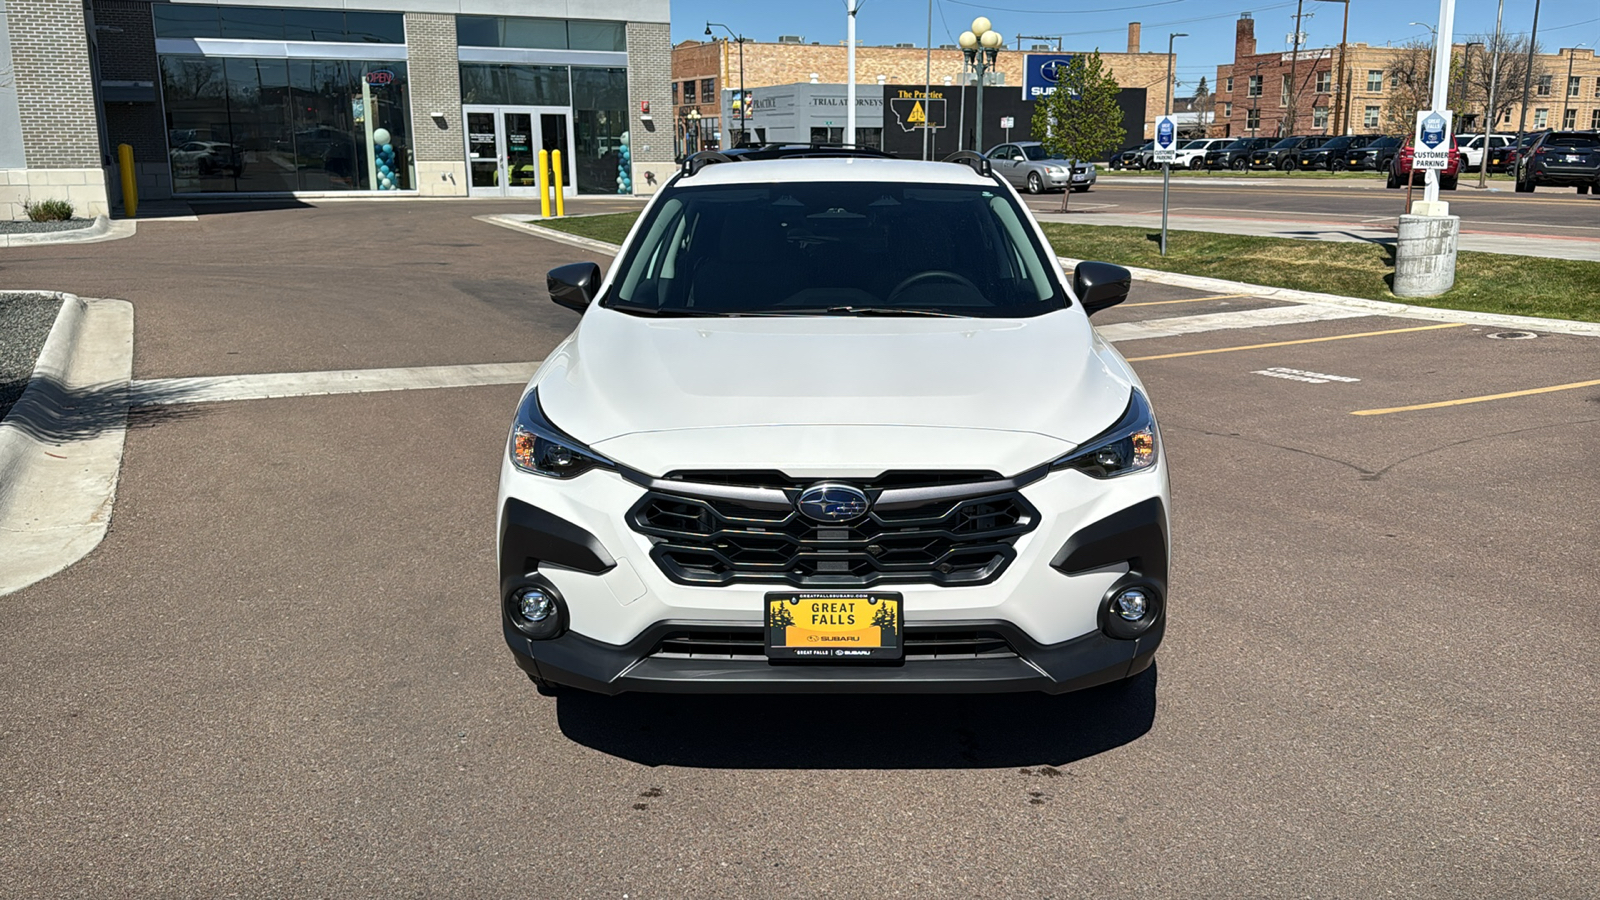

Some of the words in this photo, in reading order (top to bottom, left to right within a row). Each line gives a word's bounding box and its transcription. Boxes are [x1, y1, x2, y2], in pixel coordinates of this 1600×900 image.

[366, 72, 391, 83] OPEN
[898, 90, 913, 98] The
[1031, 87, 1080, 96] SUBRU
[813, 98, 837, 106] TRIAL
[839, 99, 883, 107] ATORNEYS
[811, 603, 855, 612] GREAT
[812, 614, 855, 624] FALLS
